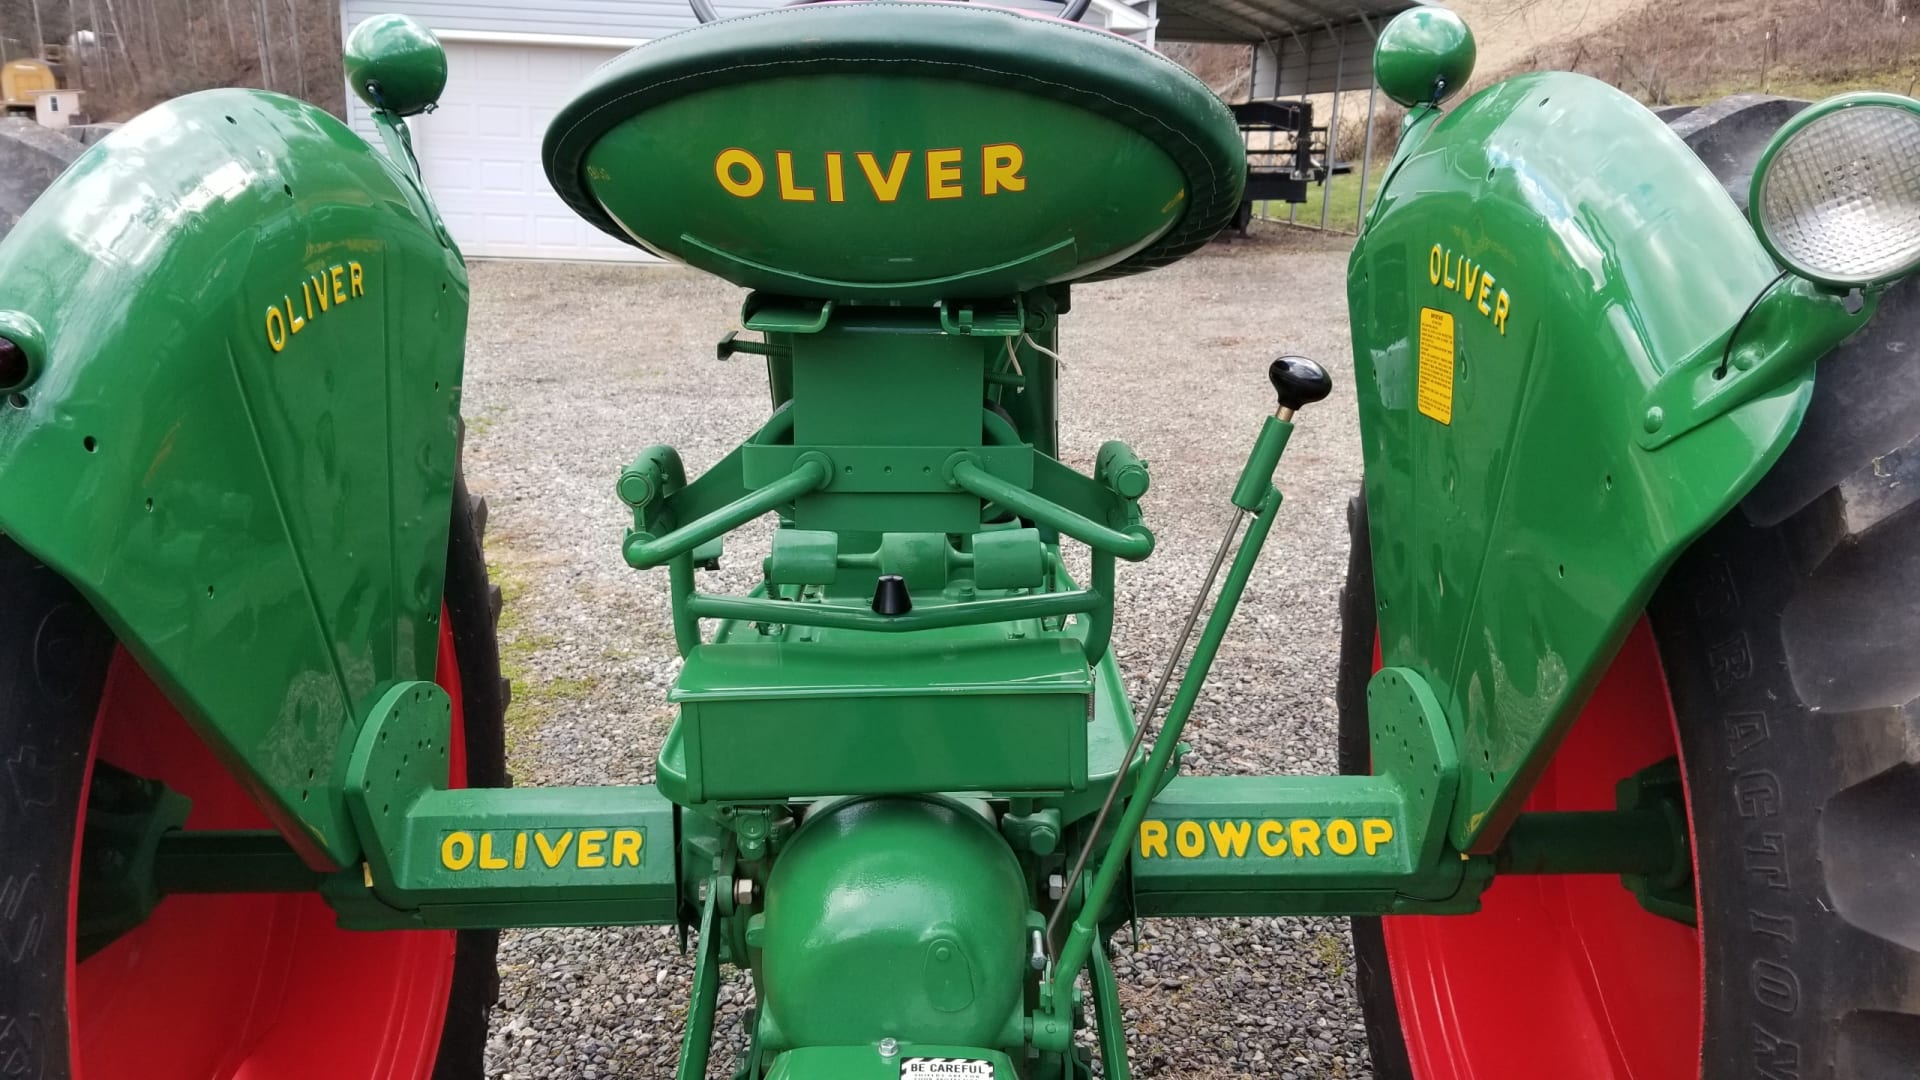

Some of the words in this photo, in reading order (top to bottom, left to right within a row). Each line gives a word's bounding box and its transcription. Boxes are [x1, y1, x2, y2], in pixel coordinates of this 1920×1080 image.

[713, 142, 1027, 203] OLIVER
[265, 261, 365, 353] OLIVER
[1429, 243, 1512, 336] OLIVER
[441, 829, 643, 871] OLIVER
[1140, 818, 1395, 859] ROWCROP
[911, 1063, 925, 1072] BE
[930, 1064, 985, 1073] CAREFUL
